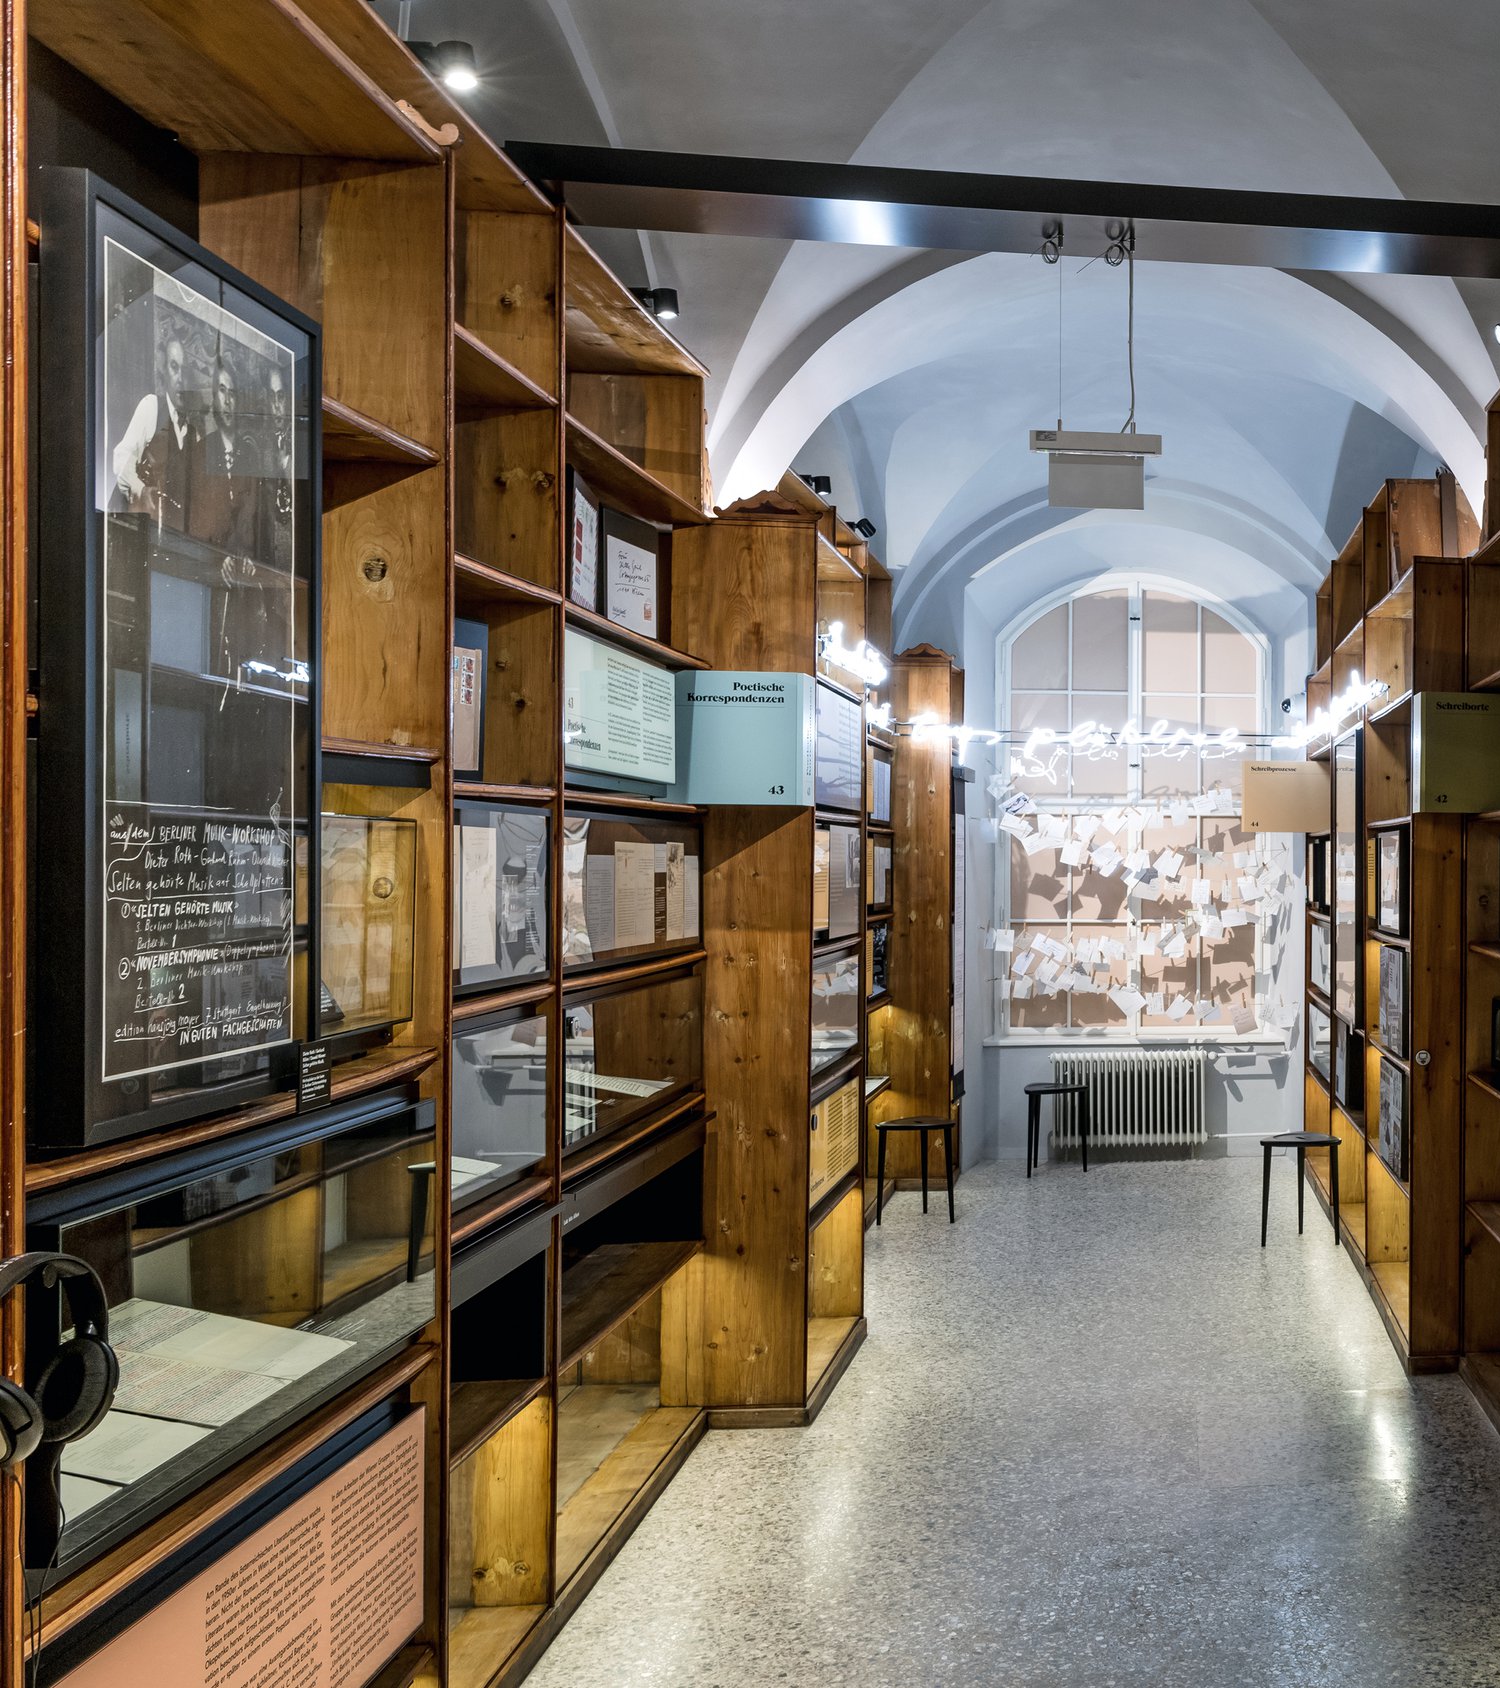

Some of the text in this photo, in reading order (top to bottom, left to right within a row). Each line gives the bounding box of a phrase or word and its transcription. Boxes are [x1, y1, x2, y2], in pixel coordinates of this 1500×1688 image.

[733, 681, 785, 693] Poetische
[687, 693, 785, 706] Korrespondenzen
[1435, 700, 1489, 712] Schreiborte
[1250, 765, 1297, 773] Schreibprozesse
[768, 785, 785, 796] 43
[1434, 794, 1448, 804] 42
[145, 851, 169, 870] Dieter
[109, 870, 141, 893] Selten
[145, 873, 185, 901] gehörte
[187, 871, 214, 892] Musik
[175, 901, 210, 916] GEHÖRTE
[179, 1030, 191, 1045] IN
[191, 1026, 218, 1043] GUTEN
